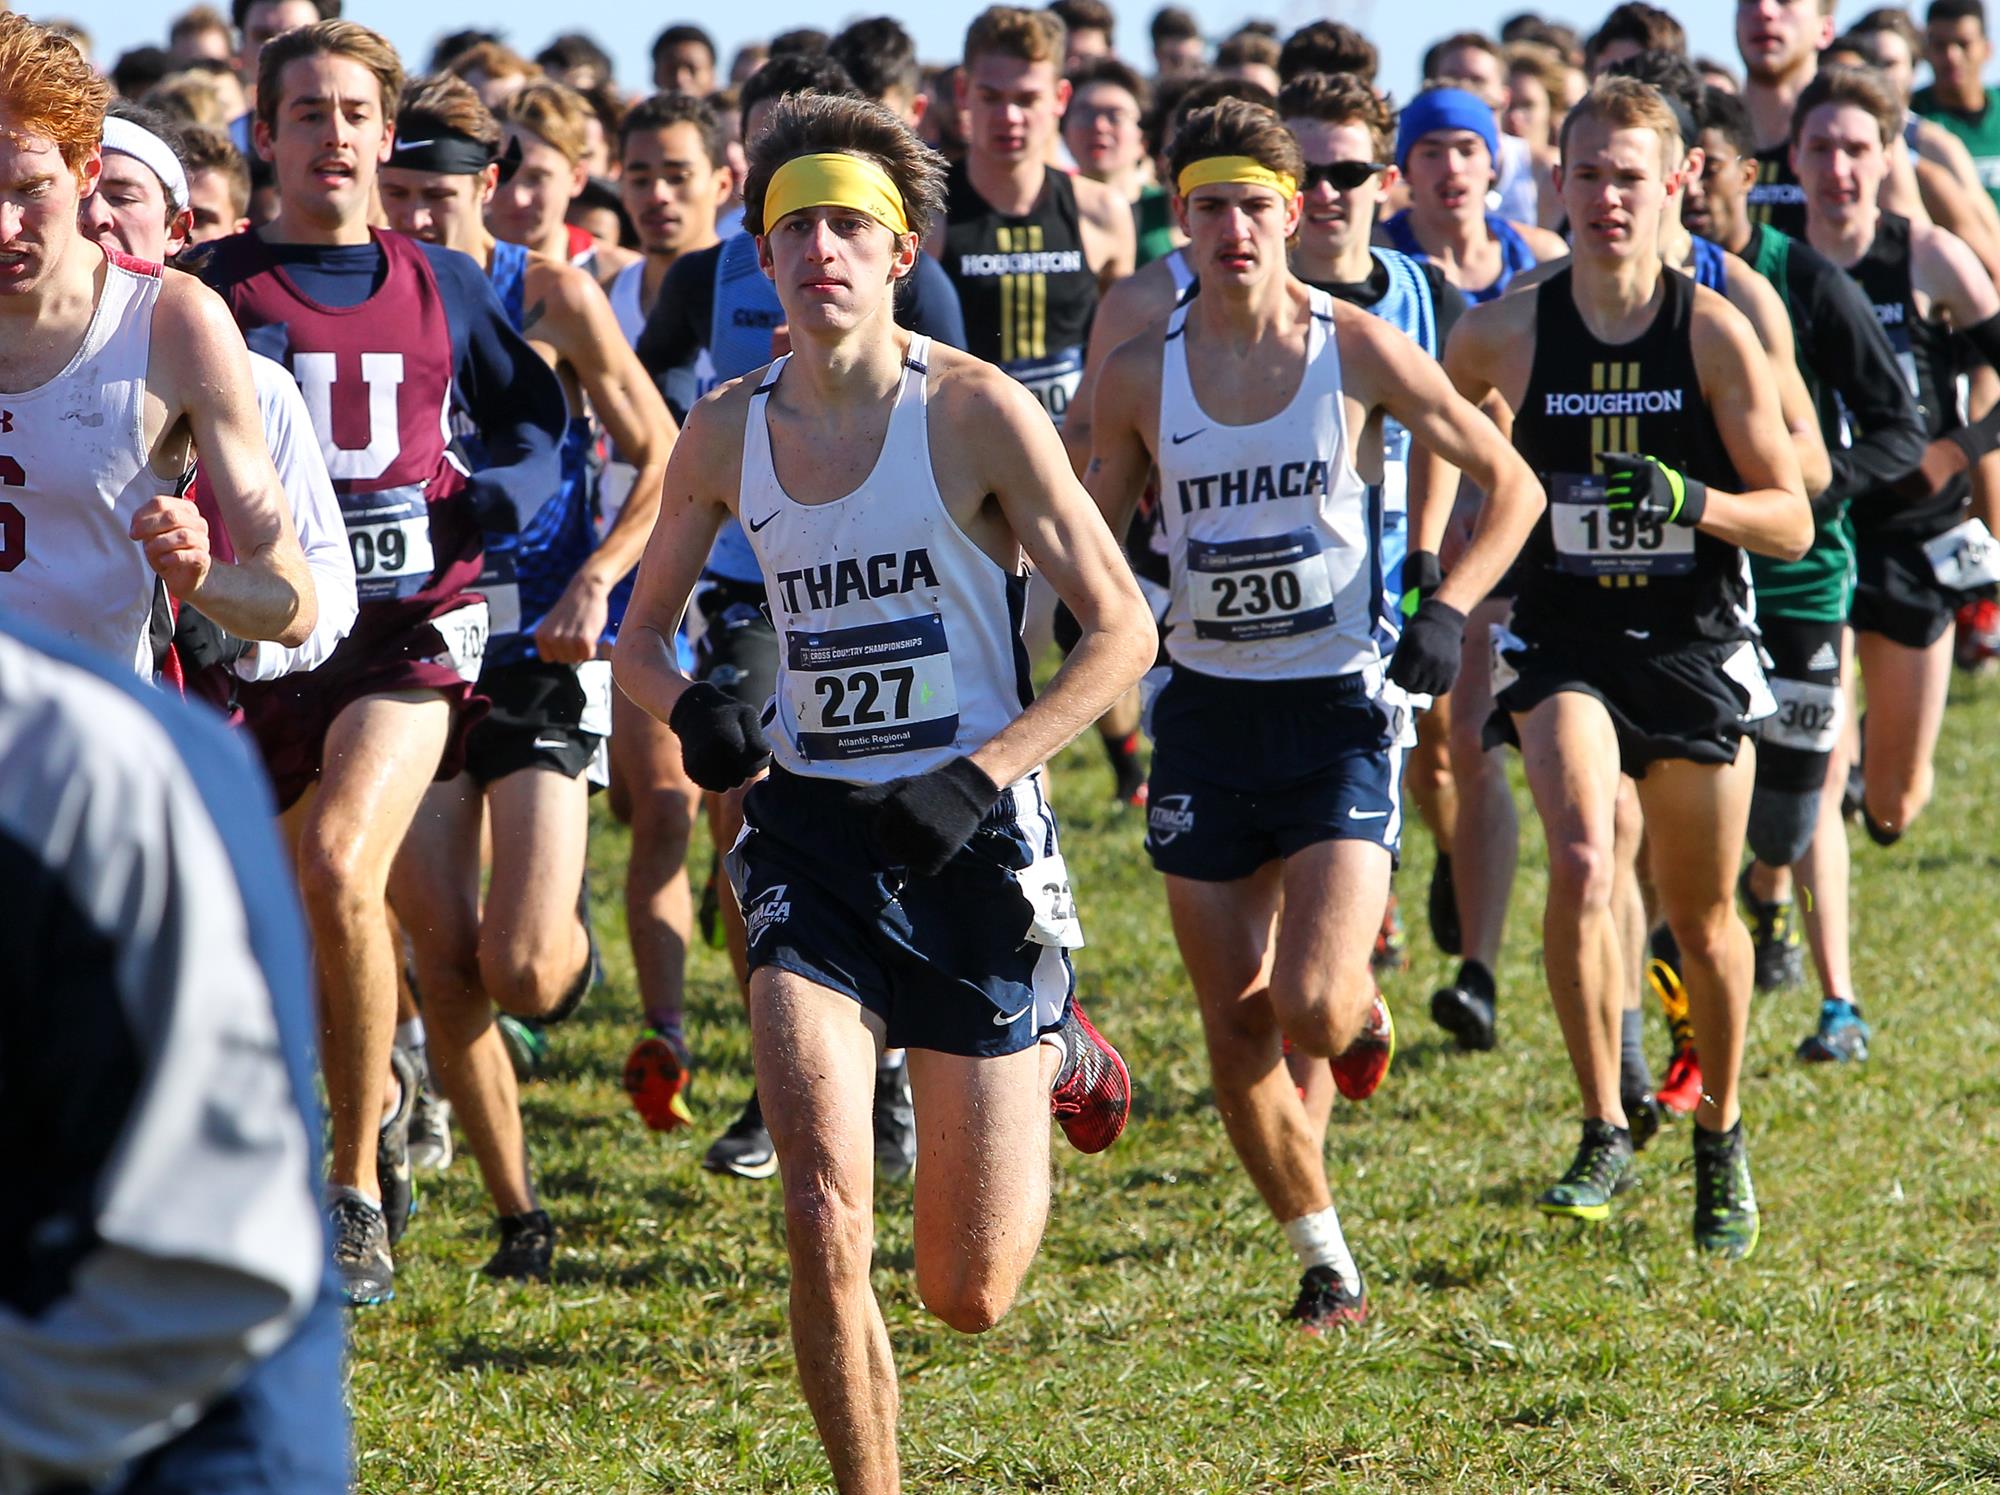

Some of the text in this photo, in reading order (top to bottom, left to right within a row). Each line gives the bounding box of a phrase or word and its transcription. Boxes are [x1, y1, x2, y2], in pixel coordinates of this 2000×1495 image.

[960, 250, 1082, 276] HOUGHTON
[293, 352, 404, 480] U
[1545, 389, 1683, 416] HOUGHTON
[1177, 460, 1329, 515] ITHACA
[1580, 509, 1664, 551] 195
[1212, 569, 1302, 617] 230
[453, 622, 487, 660] 70
[810, 650, 831, 661] CROSS
[863, 637, 923, 655] CHAMPIONSHIPS
[814, 666, 915, 728] 227
[1780, 700, 1835, 730] 302
[837, 736, 871, 748] Atlantic
[871, 730, 911, 744] Regional
